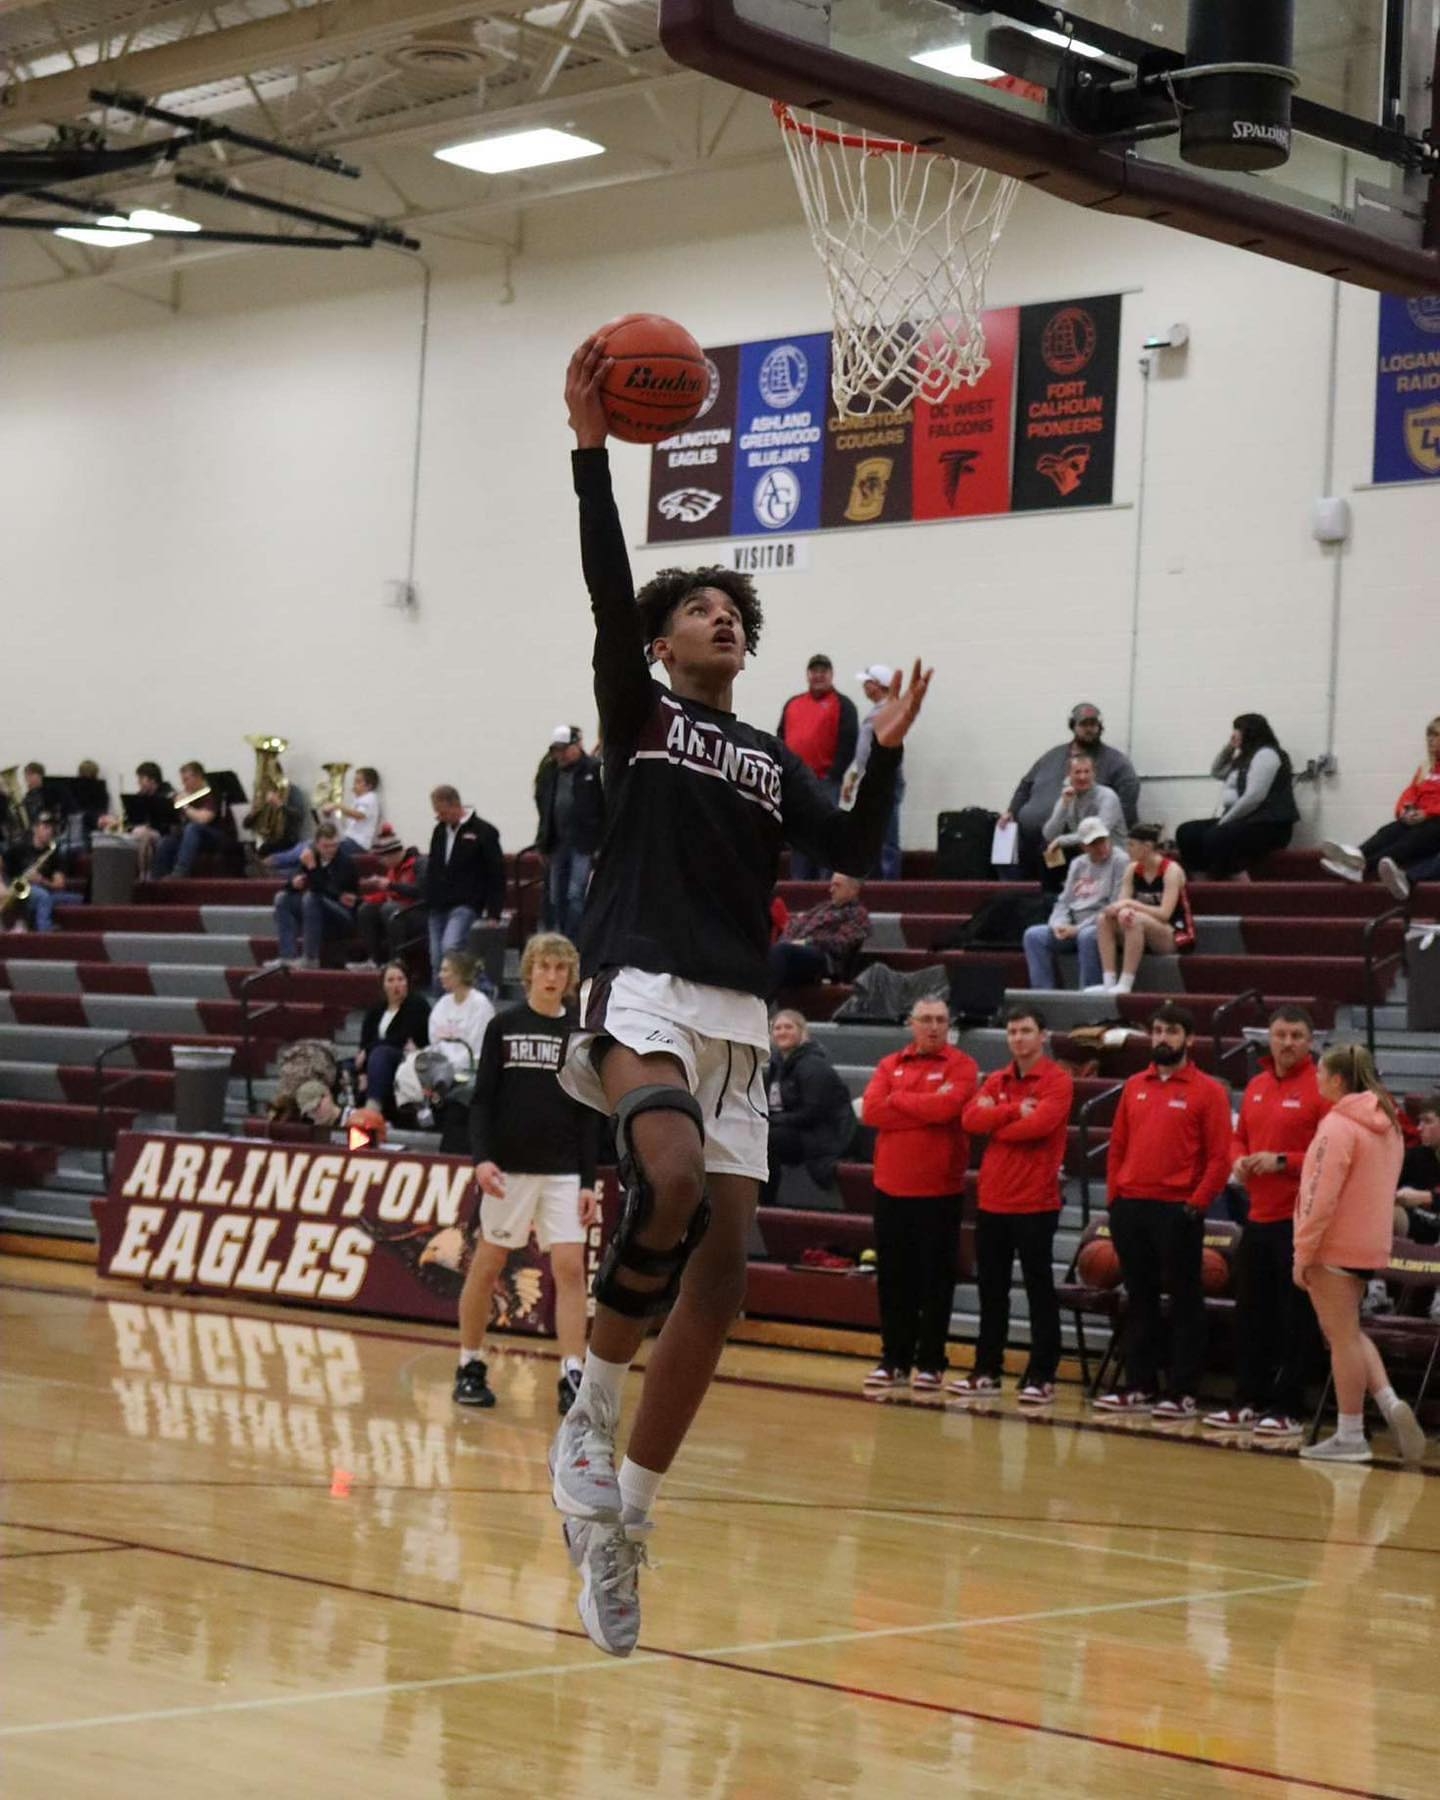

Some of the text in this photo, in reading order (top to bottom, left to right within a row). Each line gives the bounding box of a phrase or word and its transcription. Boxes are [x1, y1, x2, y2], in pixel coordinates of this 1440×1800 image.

[1047, 380, 1087, 400] FORT
[954, 399, 993, 416] WEST
[1028, 396, 1103, 418] CALHOUN
[751, 411, 811, 432] ASHLAND
[928, 420, 993, 439] FALCONS
[1027, 417, 1103, 440] PIONEERS
[739, 427, 821, 450] GREENWOOD
[836, 429, 905, 450] COUGARS
[668, 448, 718, 468] EAGLES
[748, 447, 810, 468] BLUEJAYS
[734, 544, 795, 569] VISITOR
[667, 714, 782, 808] ARINGTO
[510, 1041, 560, 1063] ARLING
[121, 1141, 475, 1226] ARLINGTON
[109, 1205, 375, 1300] EAGLES
